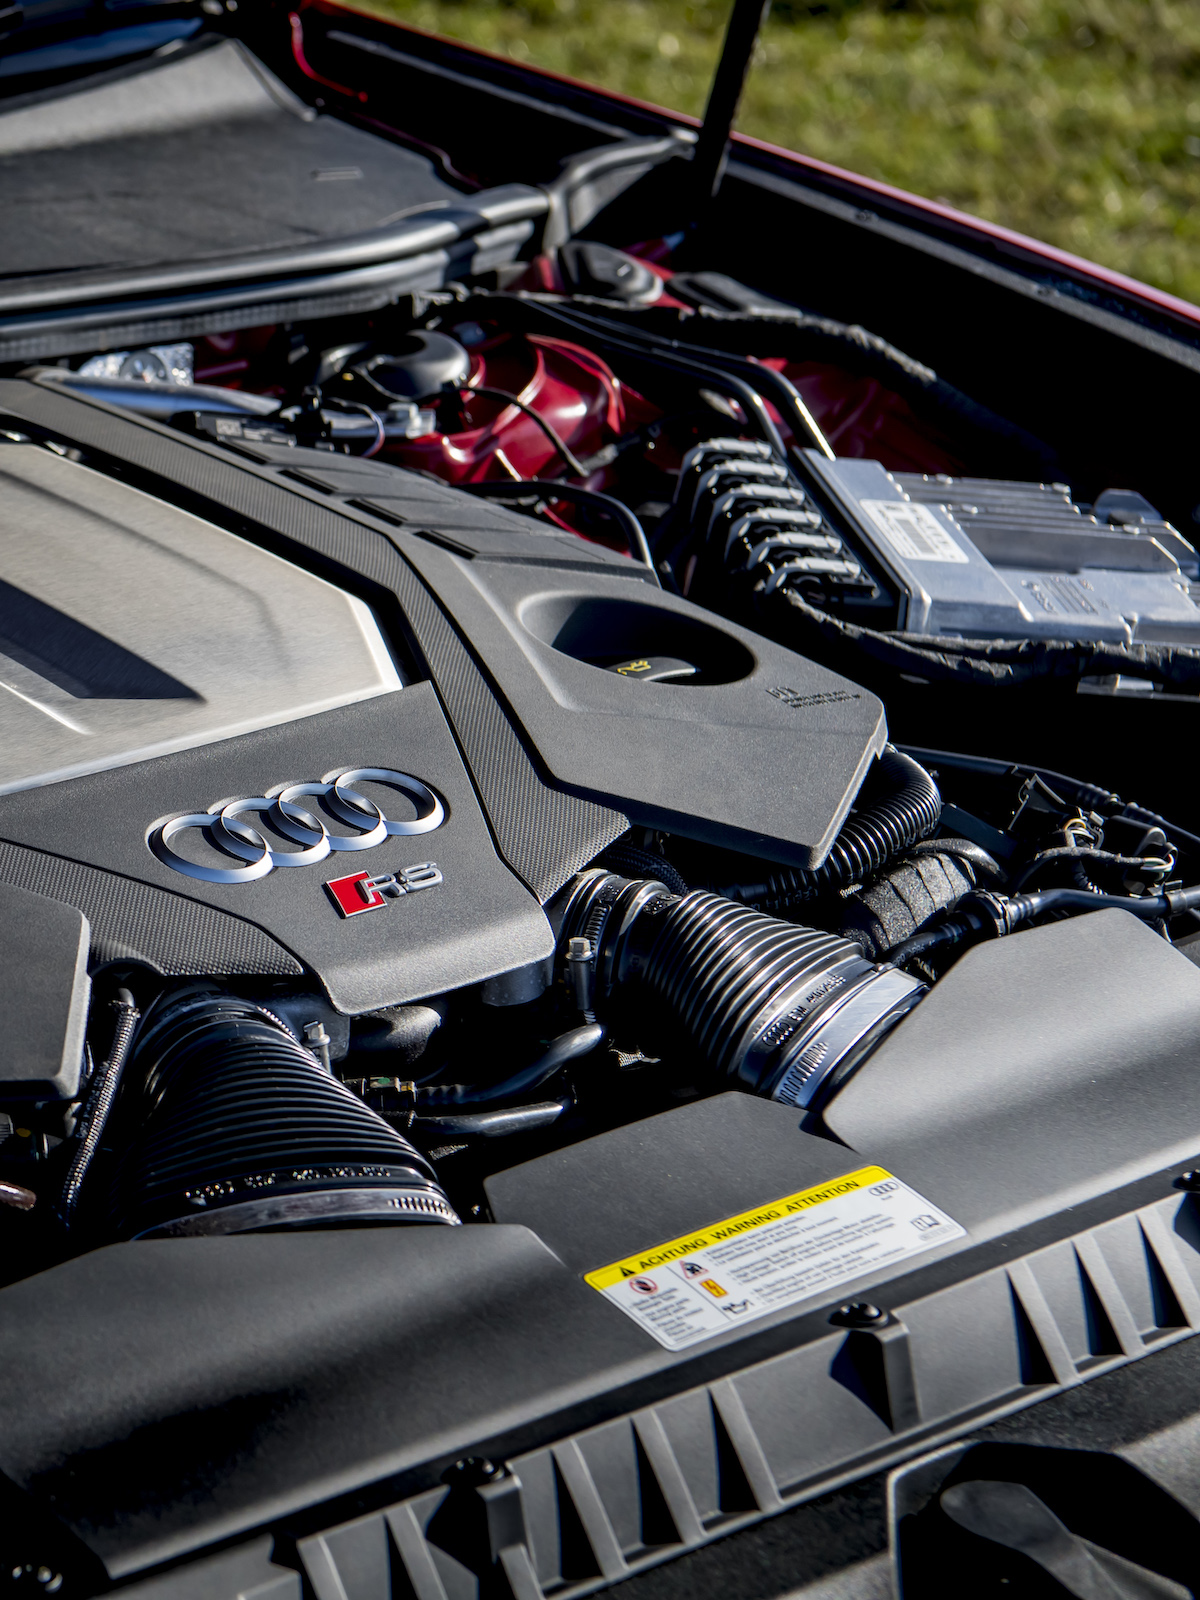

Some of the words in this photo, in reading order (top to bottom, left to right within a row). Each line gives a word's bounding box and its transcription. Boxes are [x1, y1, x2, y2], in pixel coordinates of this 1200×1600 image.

[358, 861, 443, 904] RS
[639, 1238, 708, 1270] ACHTUNG
[710, 1209, 781, 1240] WARNING
[785, 1180, 860, 1213] ATTENTION
